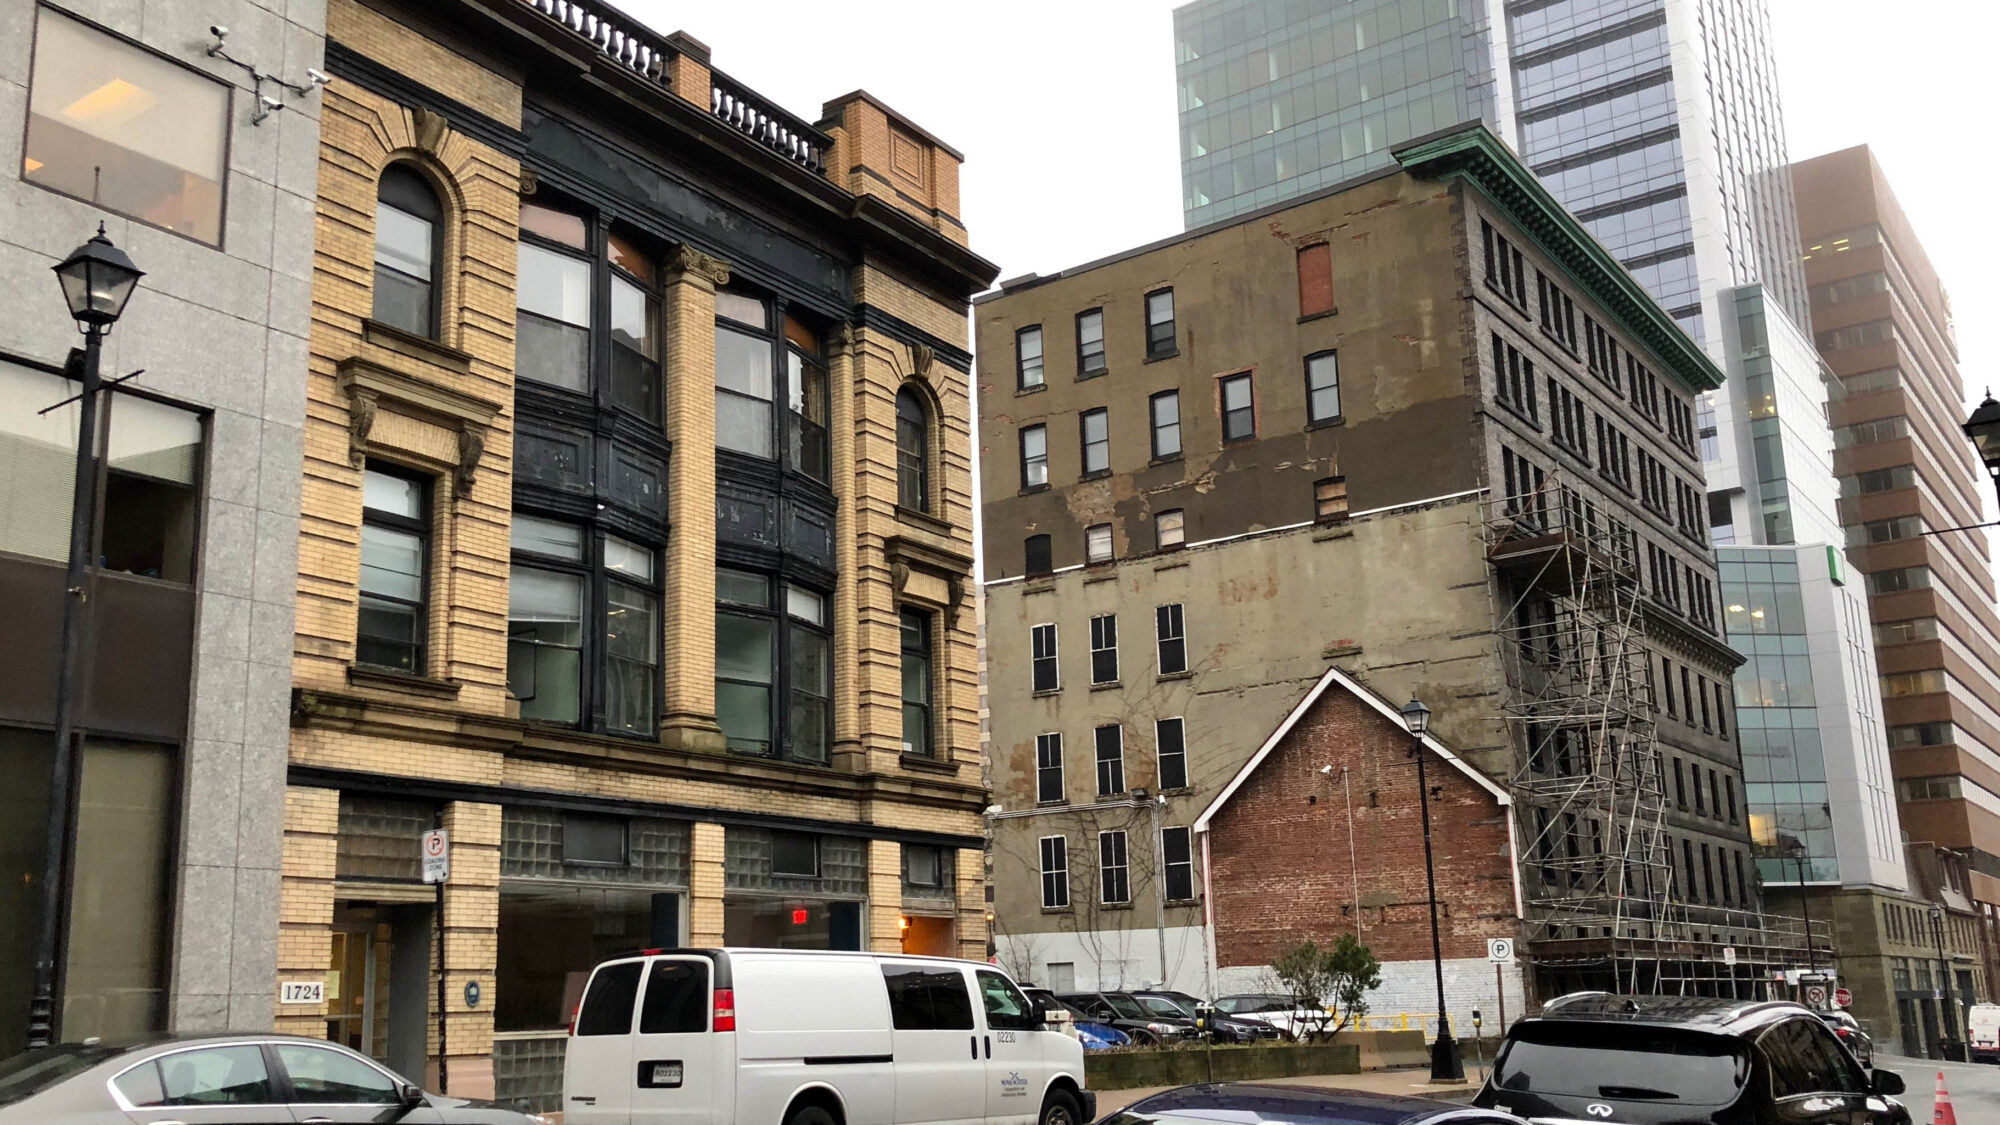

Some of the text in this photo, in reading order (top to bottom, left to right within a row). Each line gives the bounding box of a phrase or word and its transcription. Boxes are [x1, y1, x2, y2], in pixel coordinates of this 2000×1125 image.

[432, 837, 441, 850] P
[1496, 944, 1505, 954] P
[286, 985, 320, 1000] 1724
[1835, 993, 1851, 1001] STOP
[997, 1031, 1016, 1043] 02230
